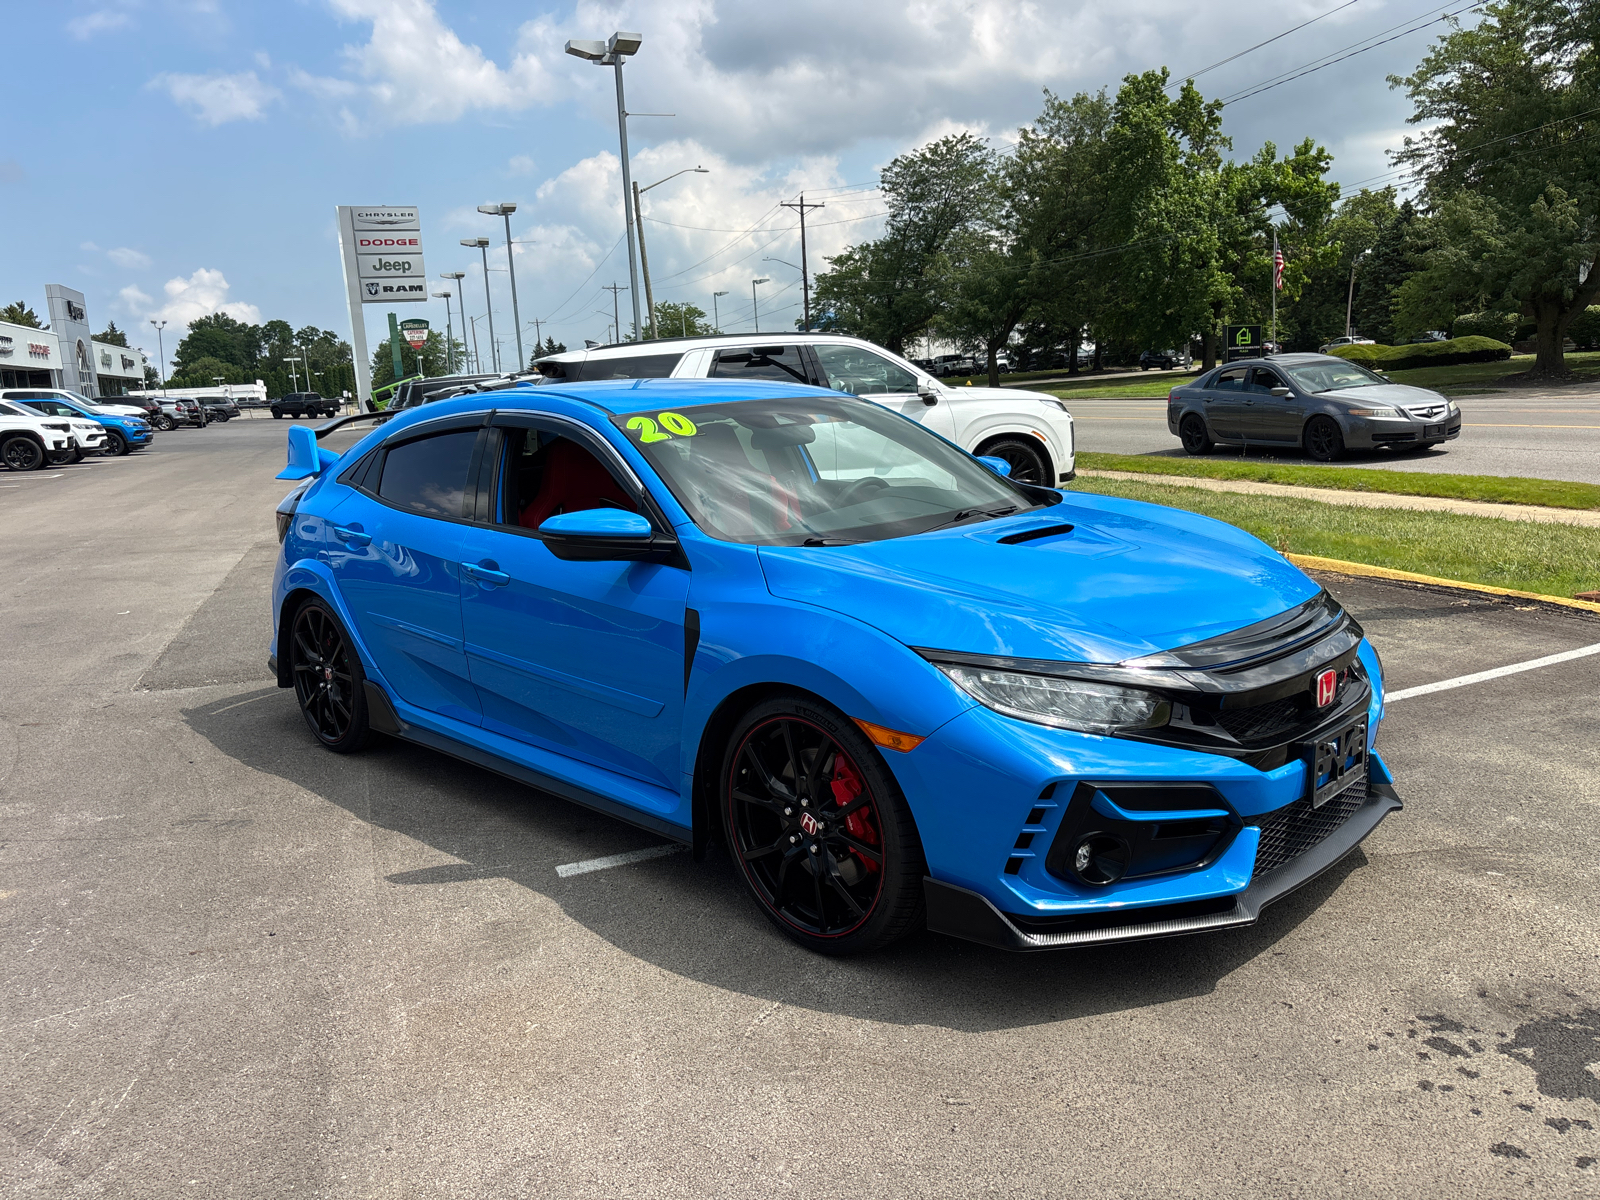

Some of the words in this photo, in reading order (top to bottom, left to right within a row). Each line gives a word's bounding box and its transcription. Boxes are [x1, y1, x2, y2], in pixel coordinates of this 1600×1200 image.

[359, 238, 419, 247] DODGE
[372, 257, 412, 274] Jeep
[382, 285, 424, 293] RAM
[626, 412, 697, 443] 20
[804, 709, 837, 732] MICHELIN
